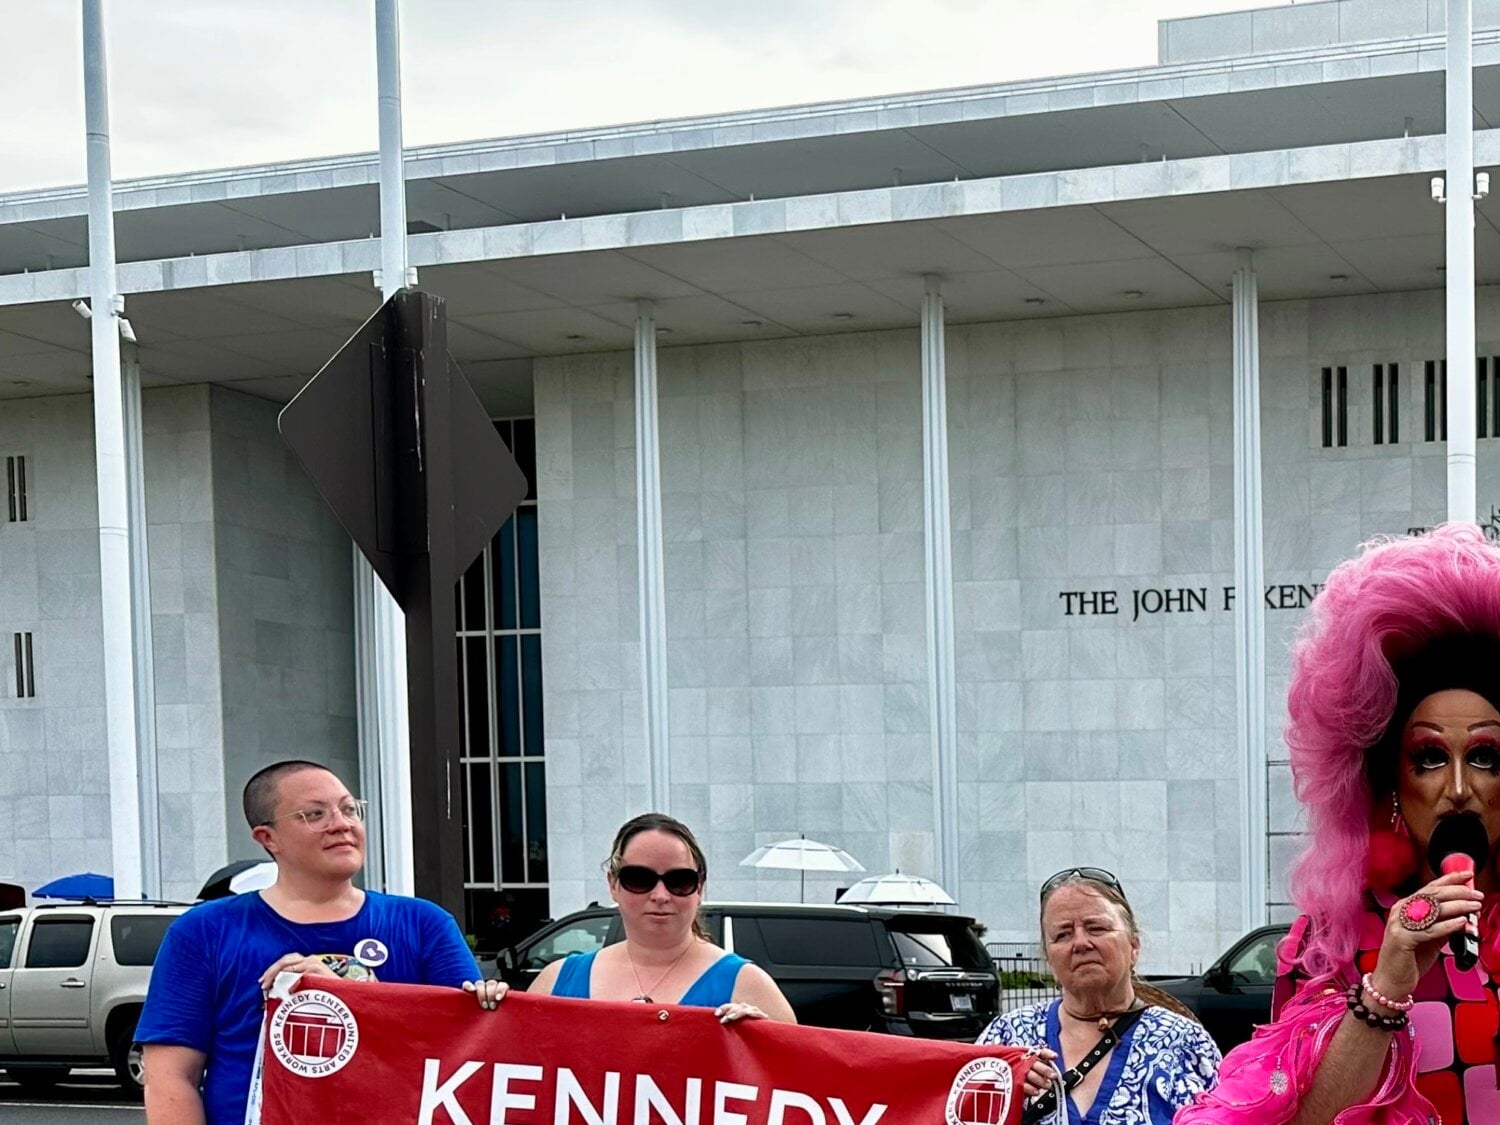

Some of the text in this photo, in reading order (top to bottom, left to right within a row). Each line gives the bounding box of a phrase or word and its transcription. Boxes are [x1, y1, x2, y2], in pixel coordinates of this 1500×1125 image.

[1058, 591, 1119, 616] THE
[1131, 587, 1208, 622] JOHN
[273, 993, 355, 1074] KENNEDY CENTER UNITED ARTS WORKERS
